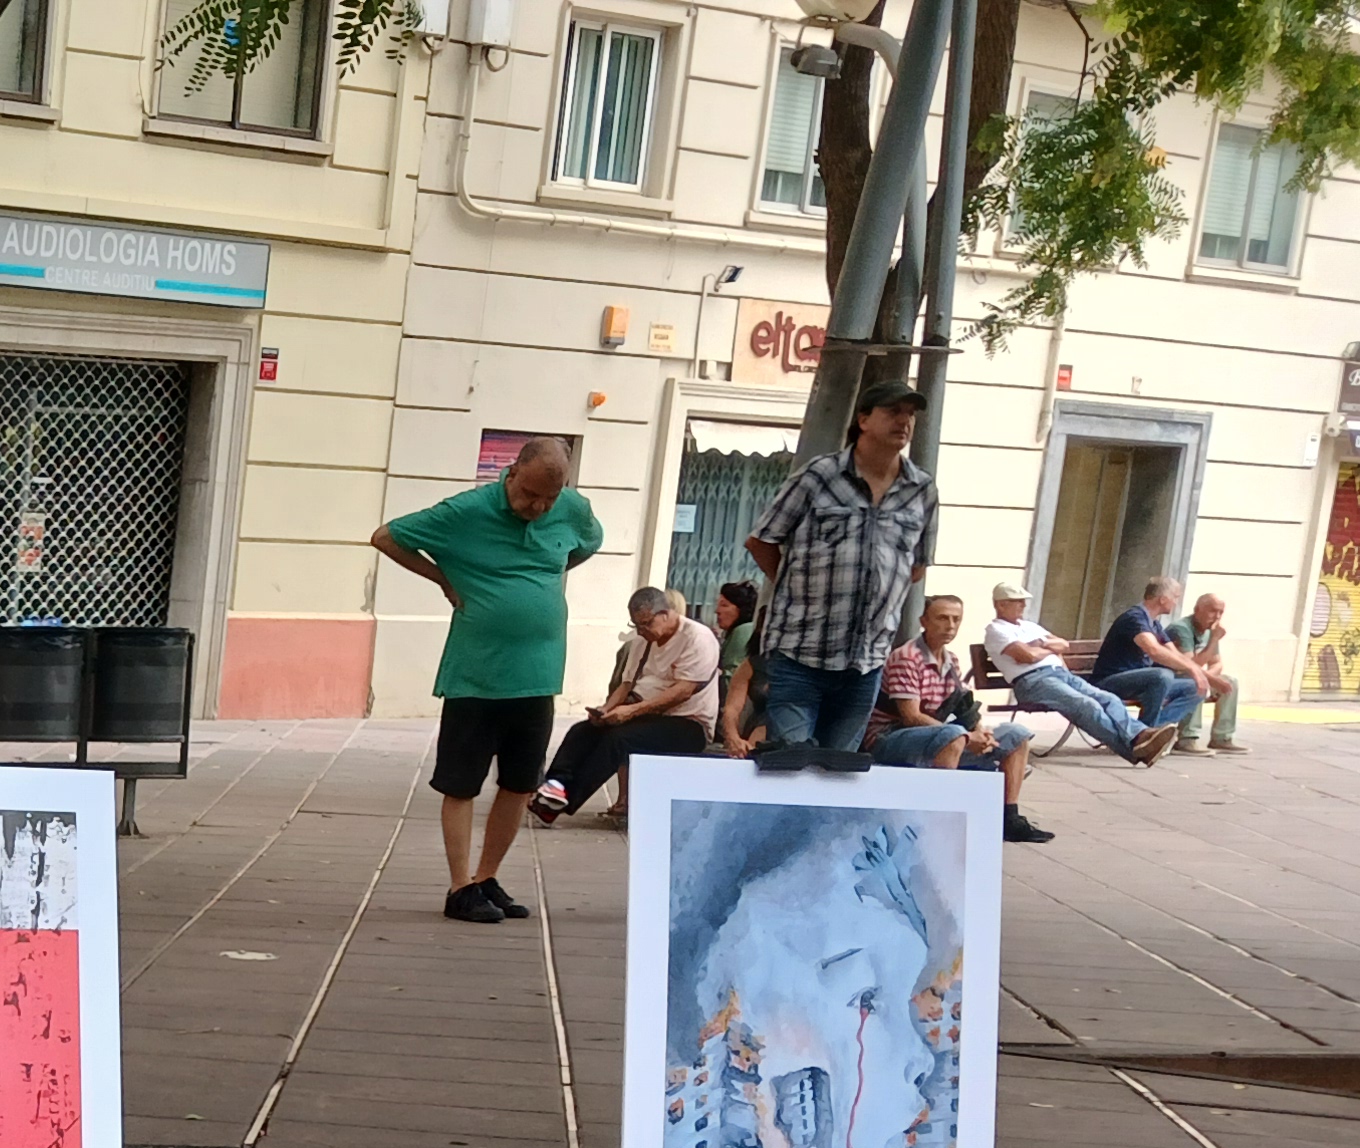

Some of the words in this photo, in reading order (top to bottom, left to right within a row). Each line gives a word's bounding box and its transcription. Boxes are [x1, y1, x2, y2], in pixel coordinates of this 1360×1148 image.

[1, 221, 160, 267] AUDIOLOGIA
[167, 239, 237, 276] HOMS
[44, 266, 99, 288] CENTRE
[102, 272, 157, 292] AUDITIU
